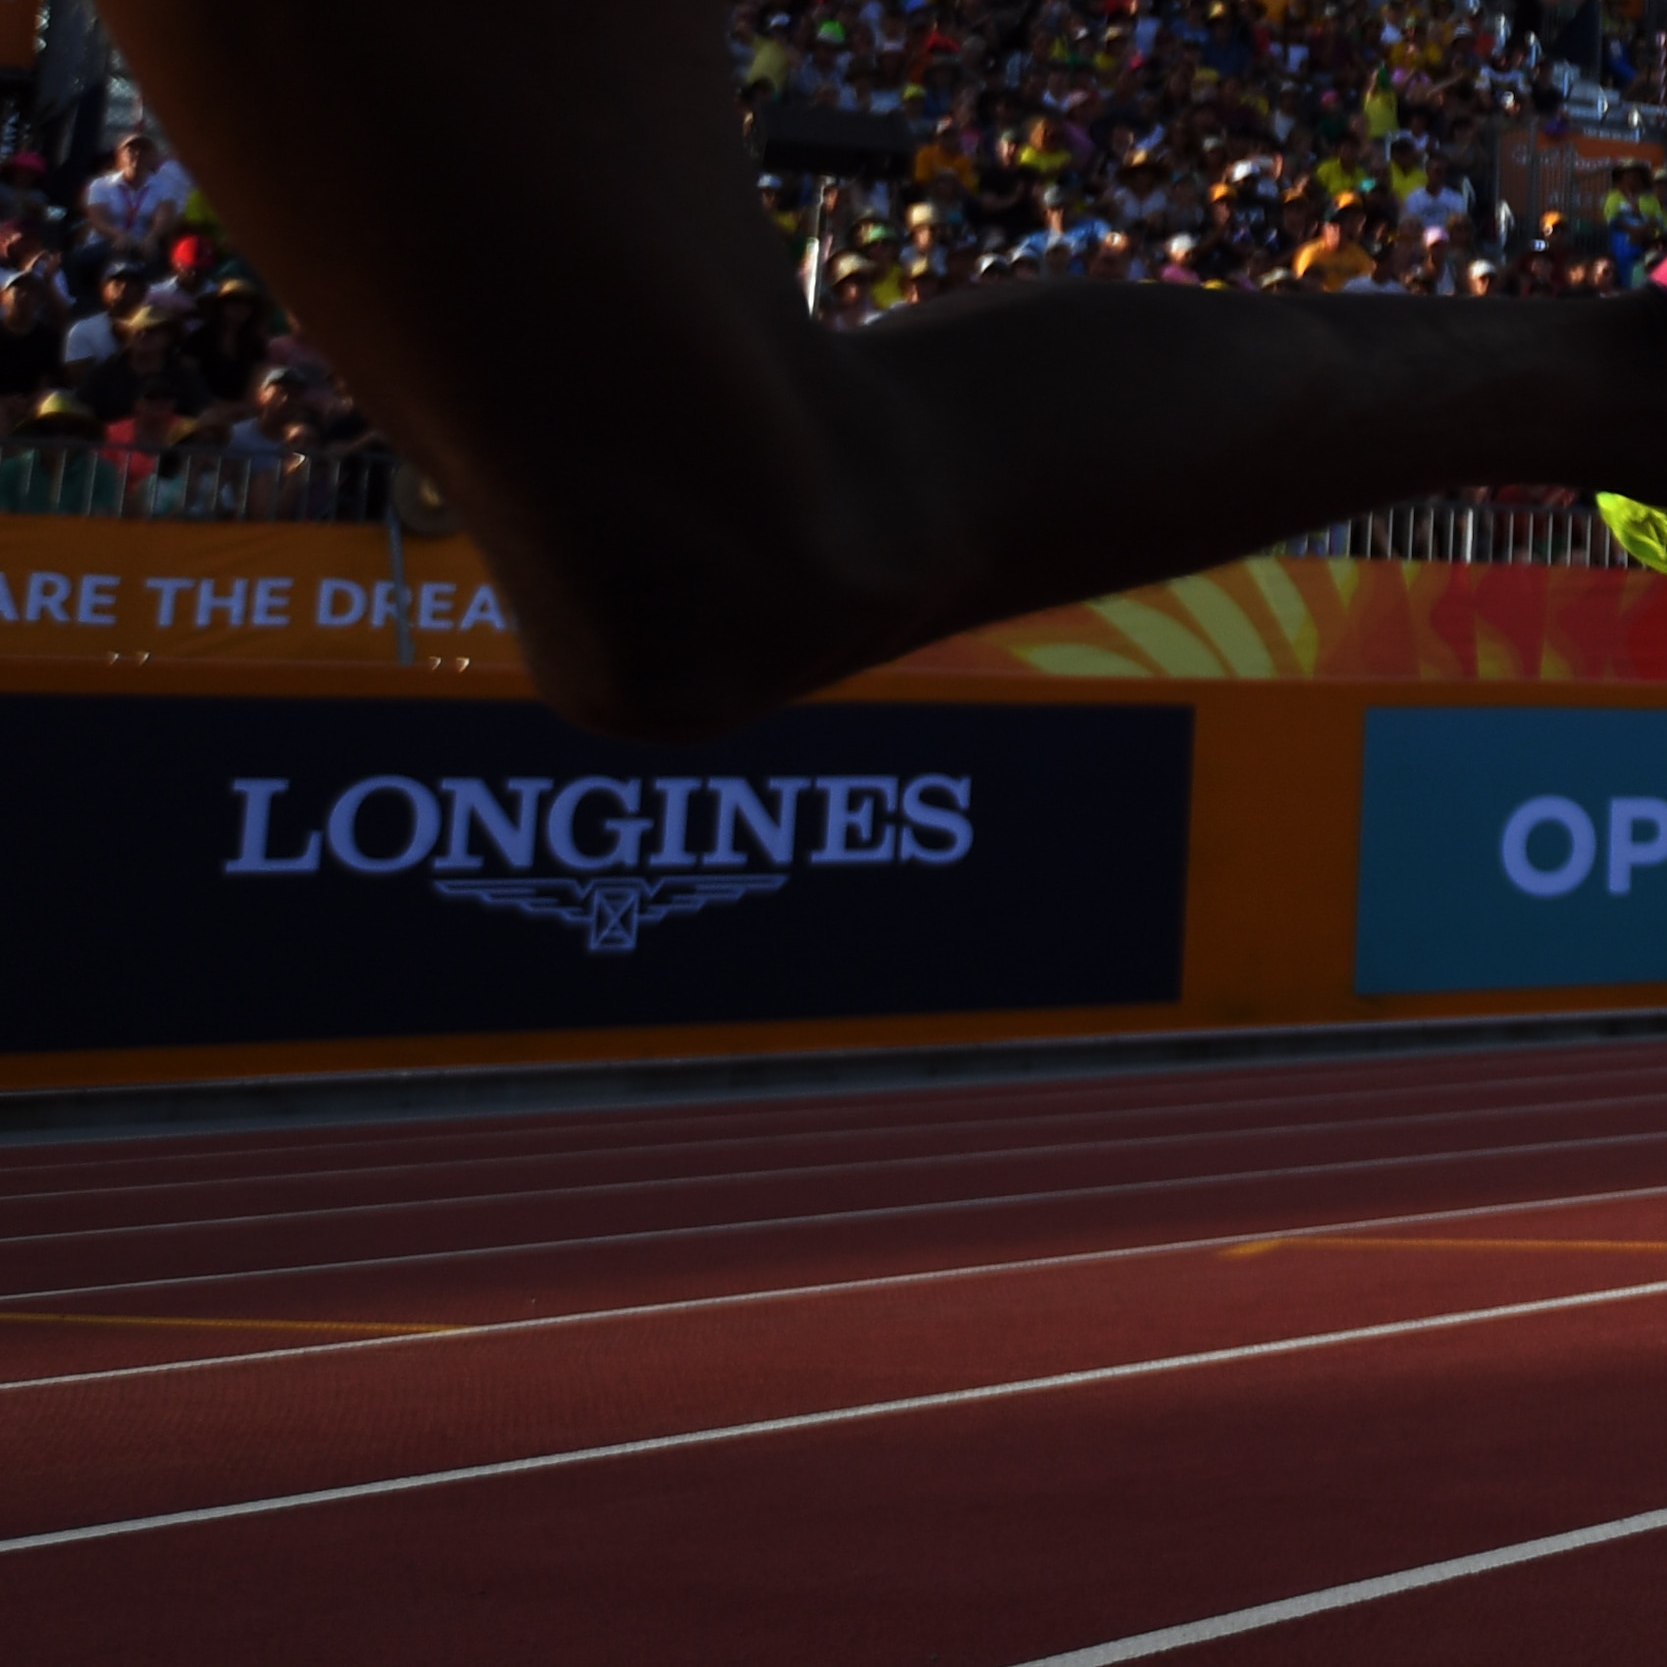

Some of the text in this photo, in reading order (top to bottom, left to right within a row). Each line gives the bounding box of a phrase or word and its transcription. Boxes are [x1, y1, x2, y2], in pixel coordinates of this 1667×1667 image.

[144, 576, 293, 628] THE
[316, 578, 514, 631] DREA
[223, 774, 974, 875] LONGINES
